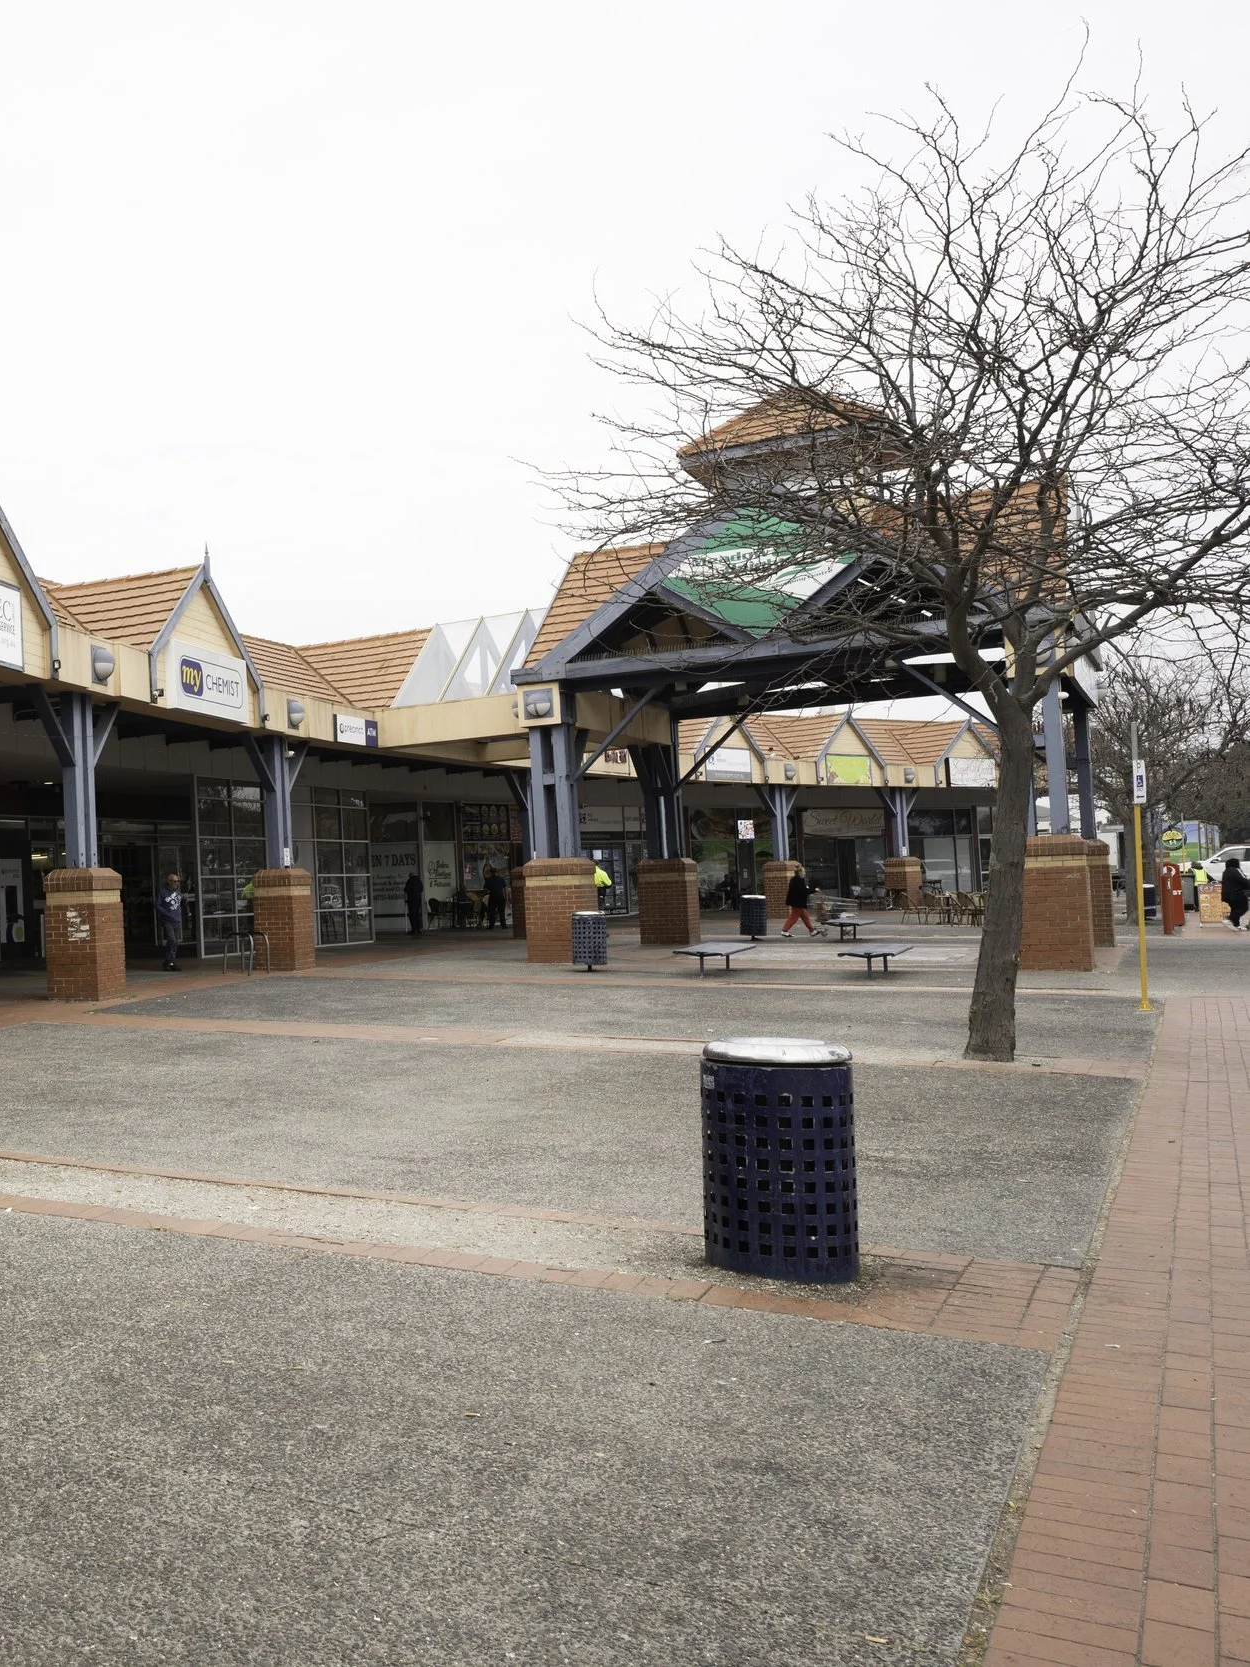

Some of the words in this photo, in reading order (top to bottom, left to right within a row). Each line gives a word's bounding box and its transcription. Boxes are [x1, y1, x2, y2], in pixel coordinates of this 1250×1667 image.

[182, 665, 202, 693] my
[205, 674, 240, 698] CHEMIST
[367, 727, 377, 737] ATM
[805, 811, 838, 828] Sweet
[840, 810, 882, 830] World
[384, 855, 390, 867] 7
[391, 853, 416, 867] DAYS
